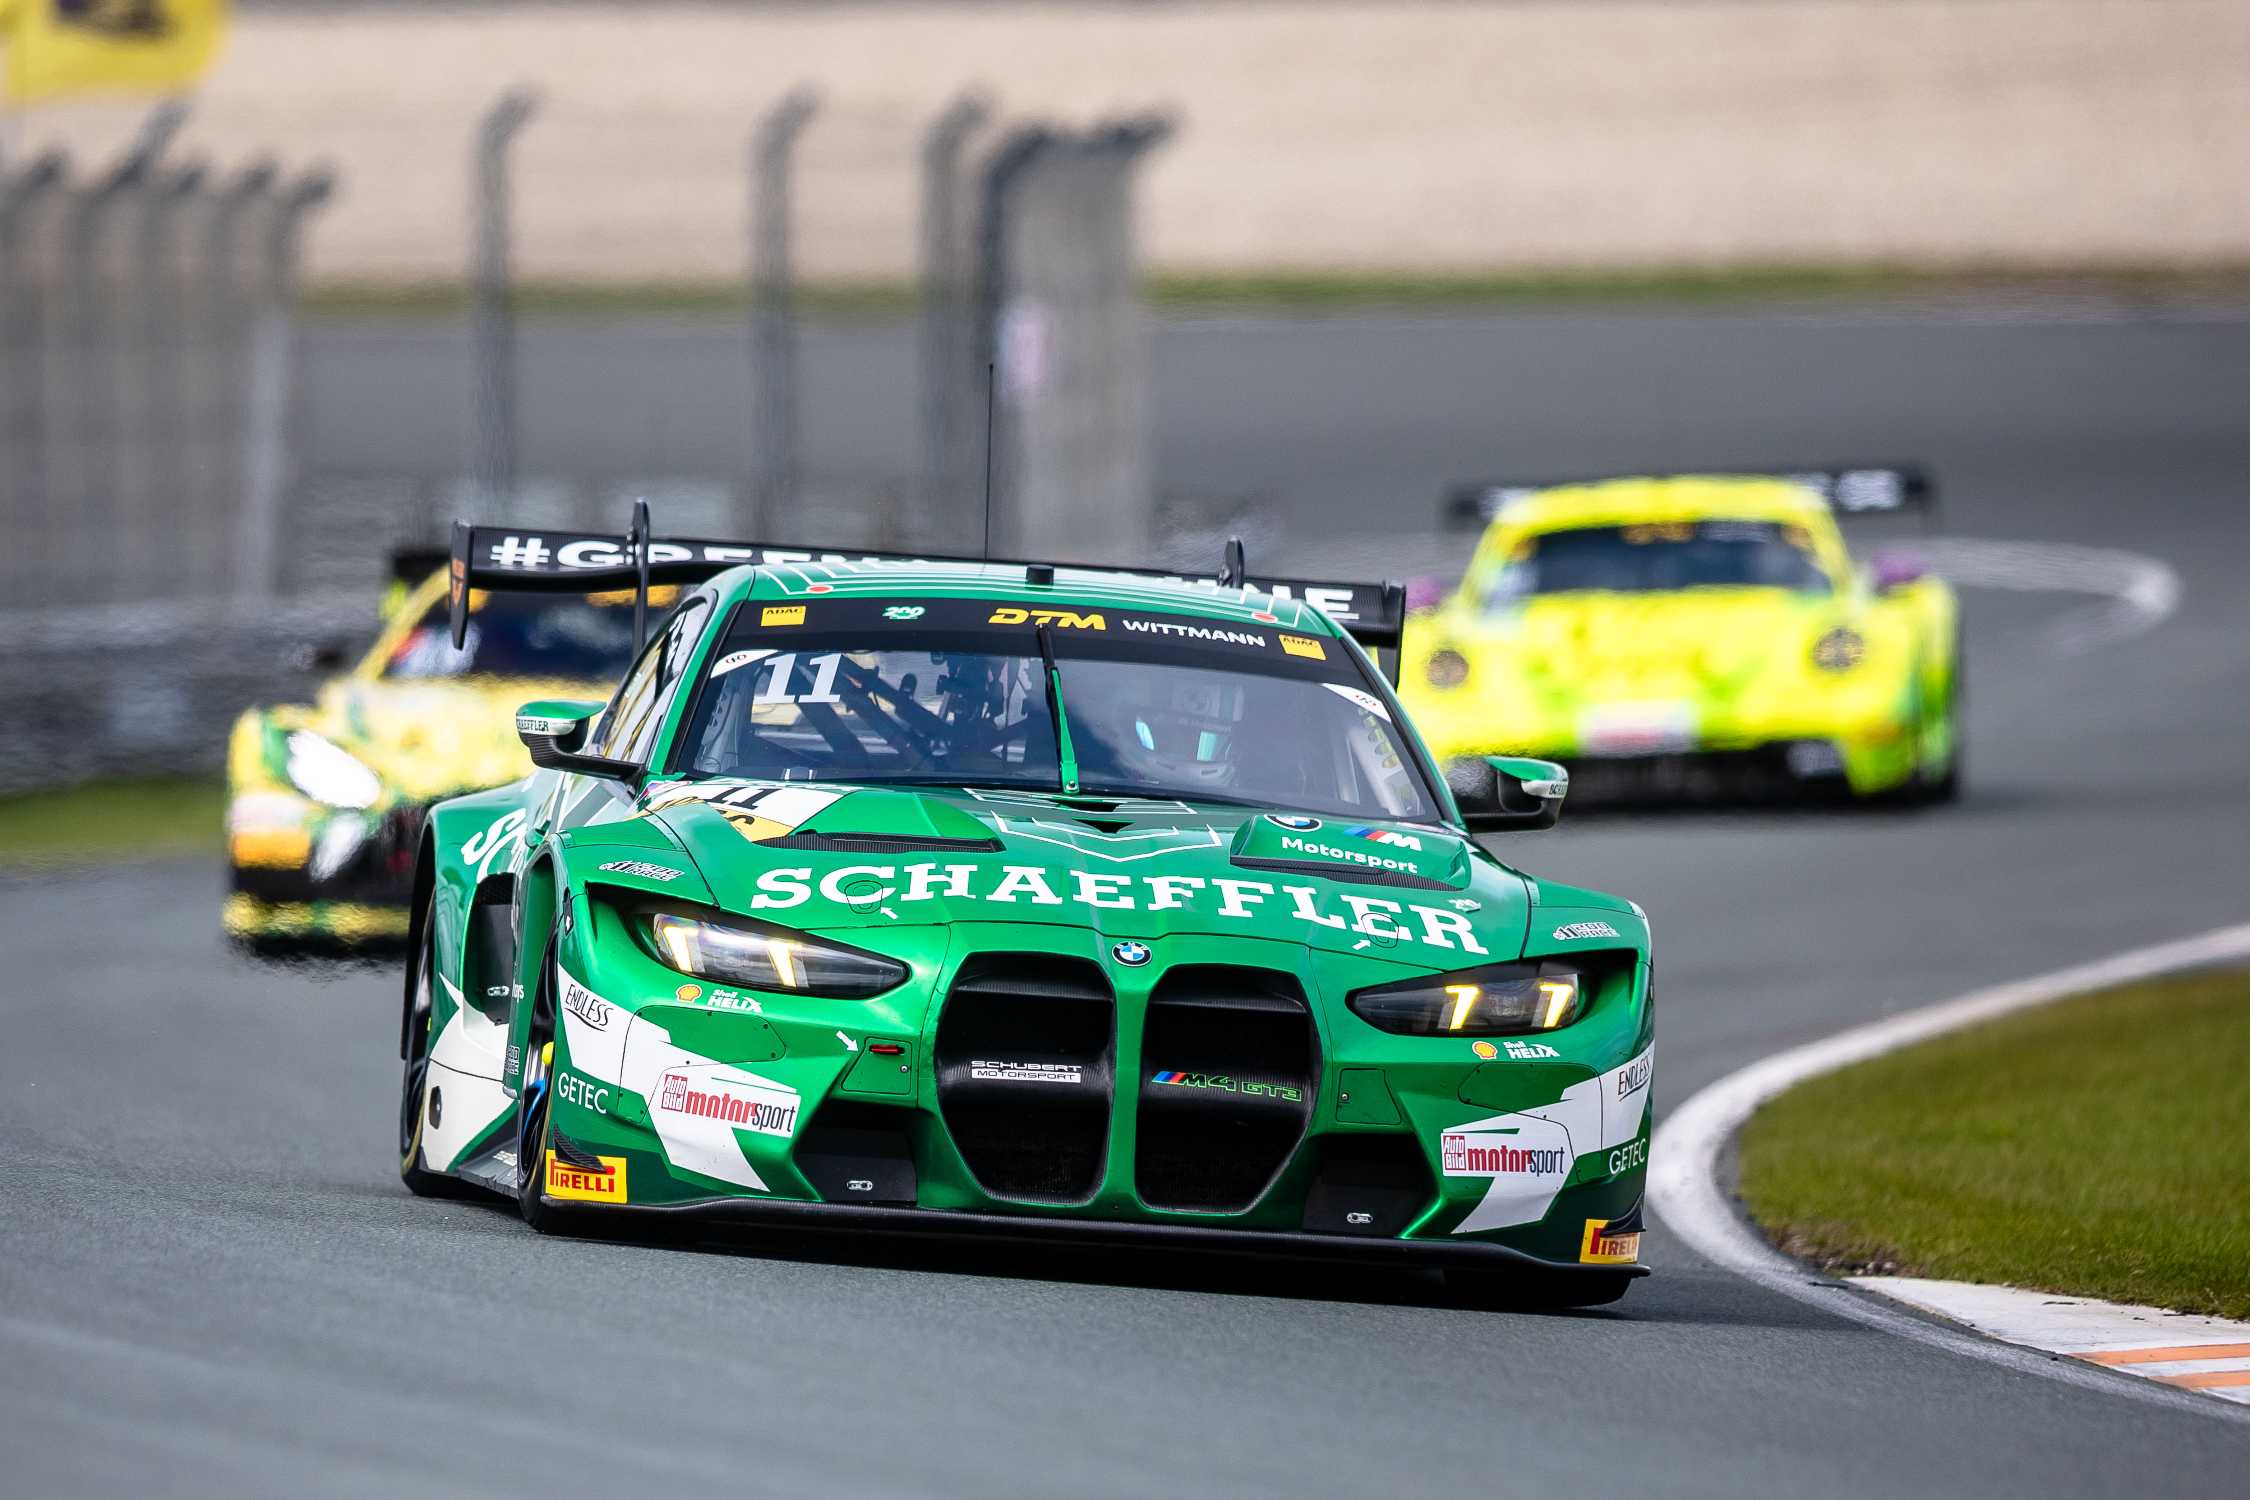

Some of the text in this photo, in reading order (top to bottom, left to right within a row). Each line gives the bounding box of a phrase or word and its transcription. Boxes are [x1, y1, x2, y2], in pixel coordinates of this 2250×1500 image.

[988, 608, 1266, 647] DTM WITTMANN
[753, 652, 842, 704] 11
[703, 786, 782, 810] 11
[1280, 836, 1418, 874] Motorsport
[751, 863, 1489, 955] SCHAEFFLER
[565, 983, 614, 1027] ENDLESS
[706, 994, 763, 1014] HELIX
[712, 988, 739, 998] Shell
[1503, 1041, 1527, 1050] Shell
[1508, 1044, 1560, 1059] HELIX
[971, 1060, 1082, 1072] SCHUBERT
[977, 1070, 1077, 1081] MOTORSPORT
[1617, 1056, 1650, 1096] ENDLESS
[558, 1072, 609, 1114] GETEC
[1183, 1073, 1302, 1102] M4 GT3
[1609, 1138, 1647, 1175] GETEC
[550, 1159, 616, 1192] PIRELLI
